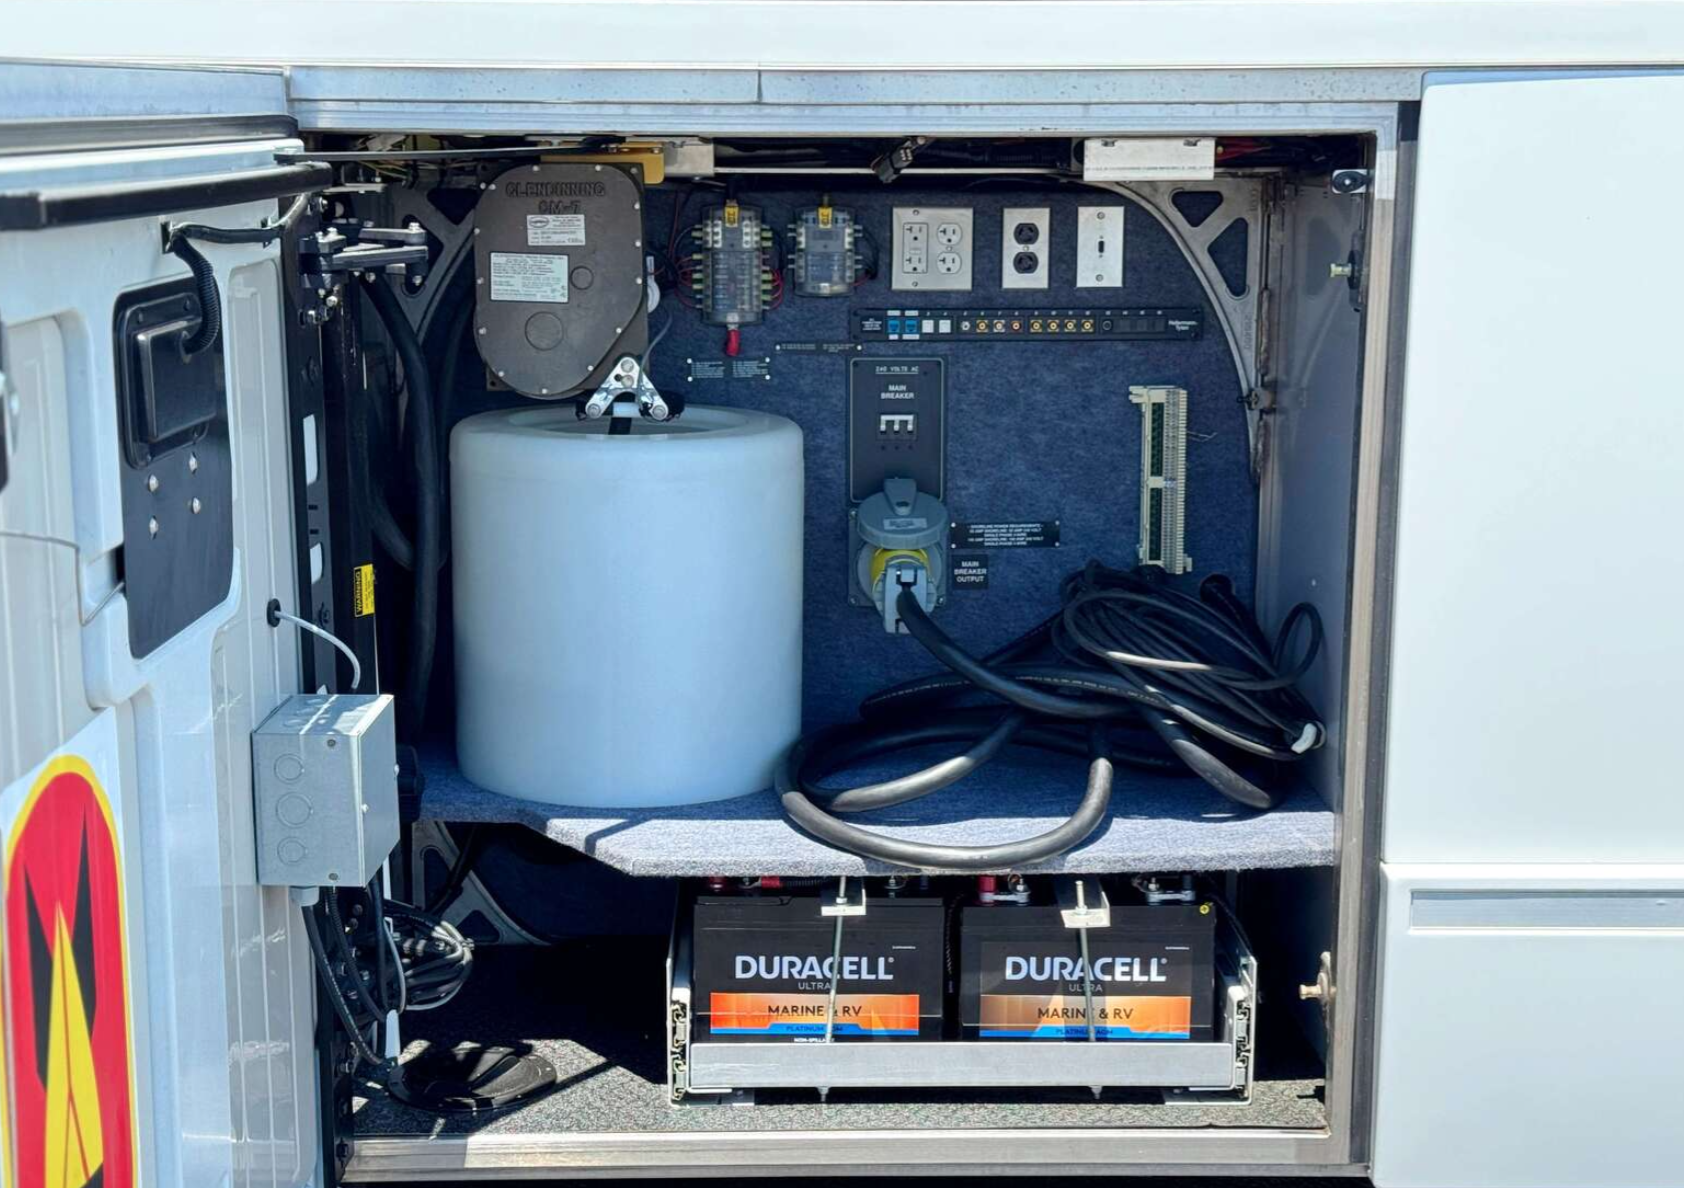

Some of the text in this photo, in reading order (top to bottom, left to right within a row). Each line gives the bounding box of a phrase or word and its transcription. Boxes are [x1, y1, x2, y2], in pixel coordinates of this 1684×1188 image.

[506, 182, 605, 197] GLENDINNING
[880, 392, 915, 400] BREAKER
[956, 575, 985, 583] OUTPUT
[798, 982, 831, 990] ULTRA
[768, 1005, 824, 1016] MARINE
[842, 1006, 862, 1016] RV
[1037, 1007, 1134, 1019] MARIN & RV
